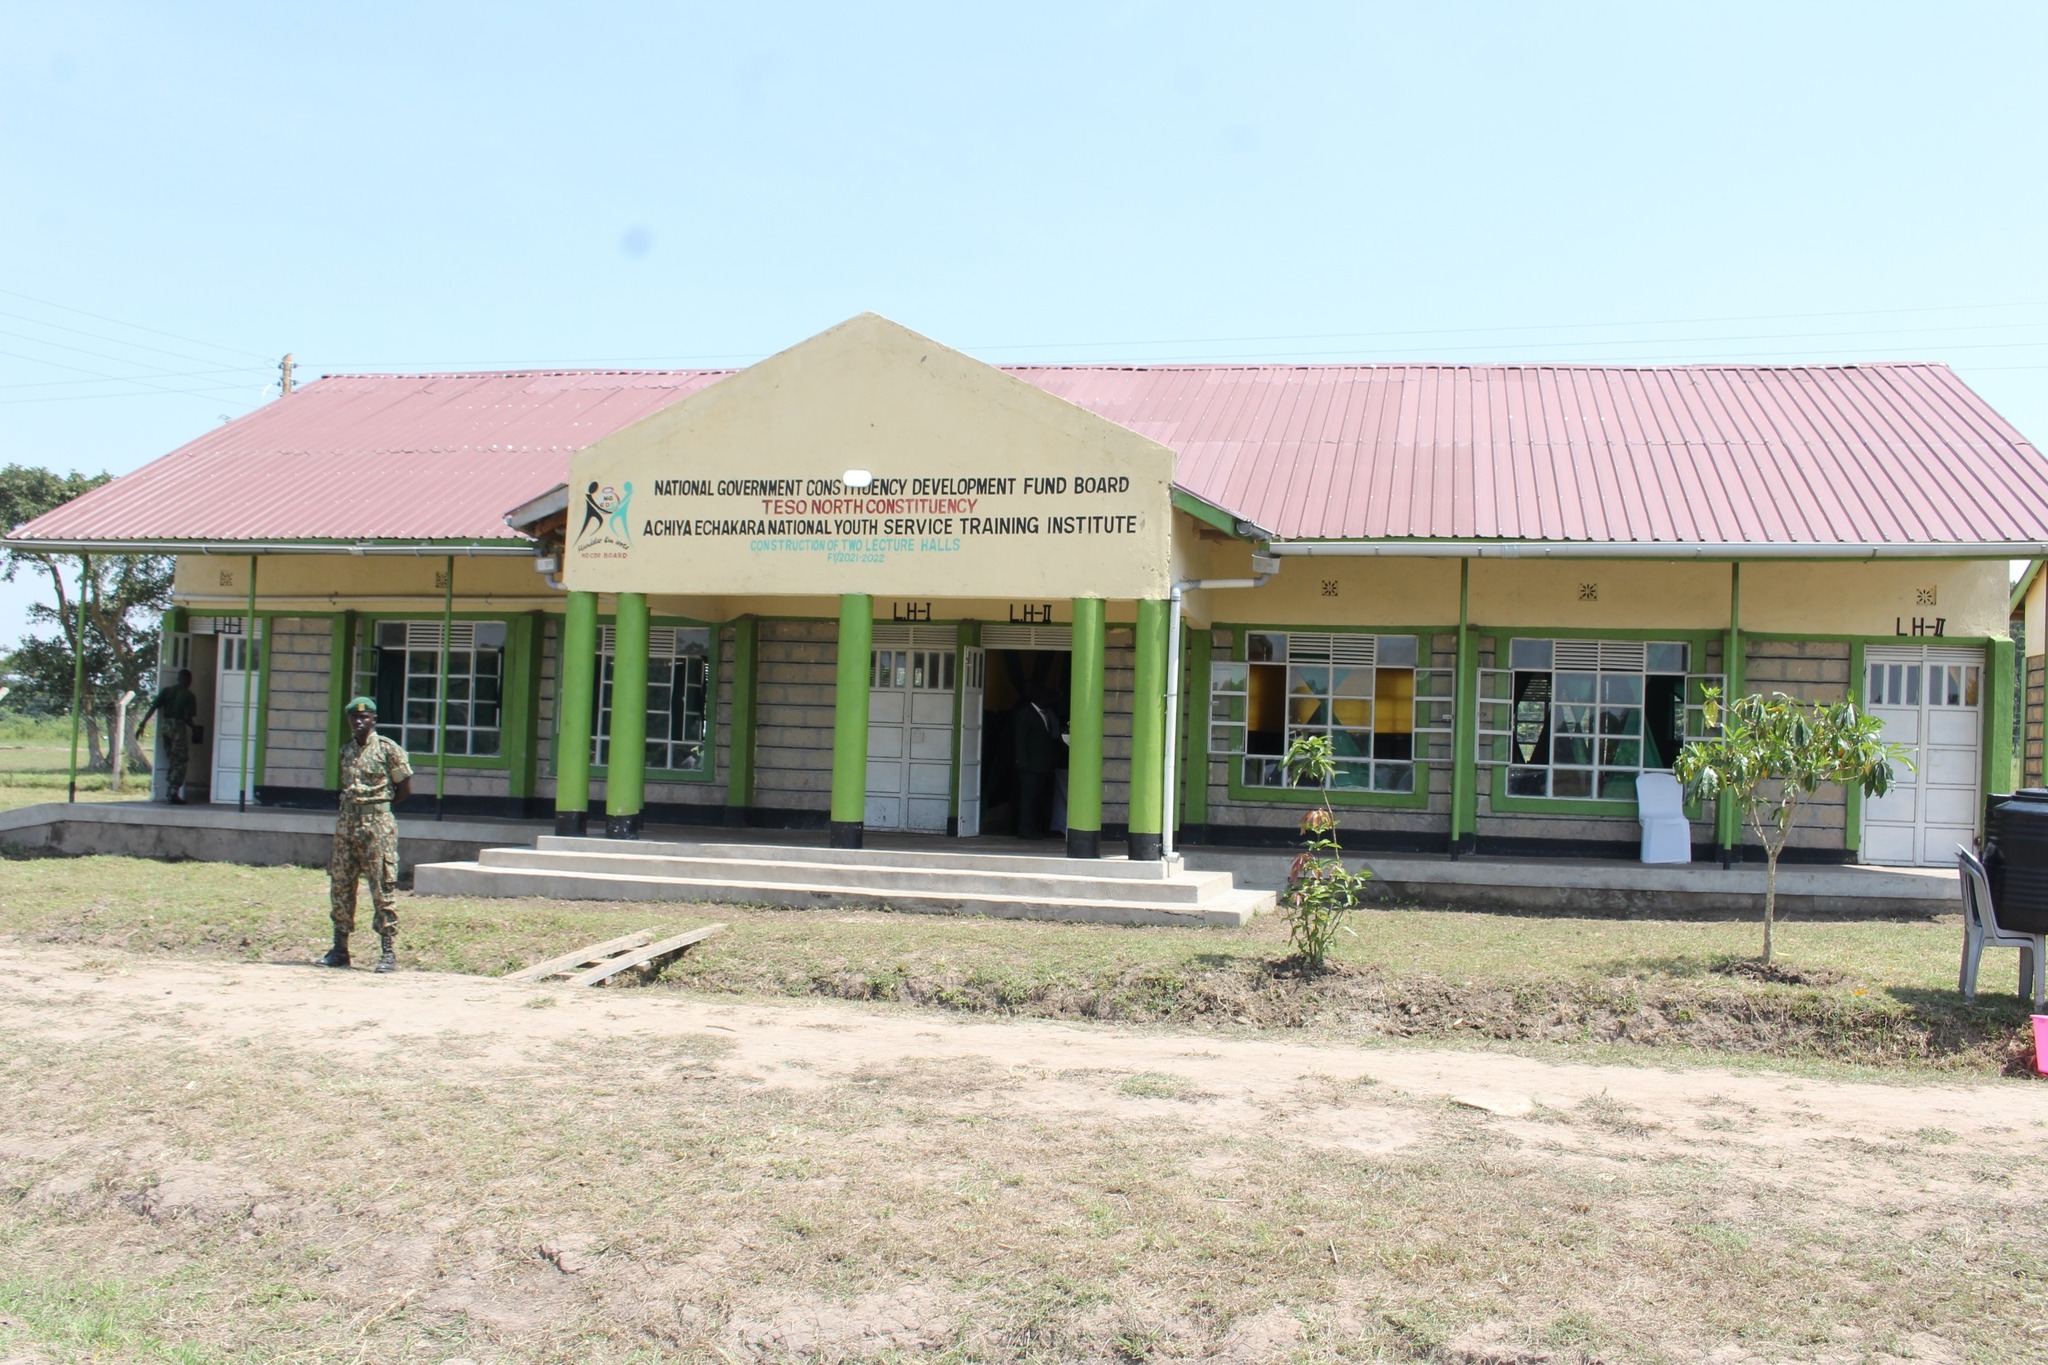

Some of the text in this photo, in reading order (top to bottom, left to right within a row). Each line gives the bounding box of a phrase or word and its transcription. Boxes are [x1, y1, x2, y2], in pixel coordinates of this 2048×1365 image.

[654, 479, 714, 496] NATIONAL
[717, 479, 803, 496] GOVERNMENT
[912, 477, 1017, 496] DEVELOPMENT
[1023, 476, 1067, 495] FUND
[1074, 476, 1130, 494] BOARD
[762, 498, 978, 515] TESO NORTH CONSTITUENCY
[643, 515, 1137, 536] ACHIYA ECHAKARA NATIONAL YOUTH SERVICE TRAINING INSTITUTE
[750, 537, 961, 552] CONSTRUCTION OF TWO LECTURE HALLS
